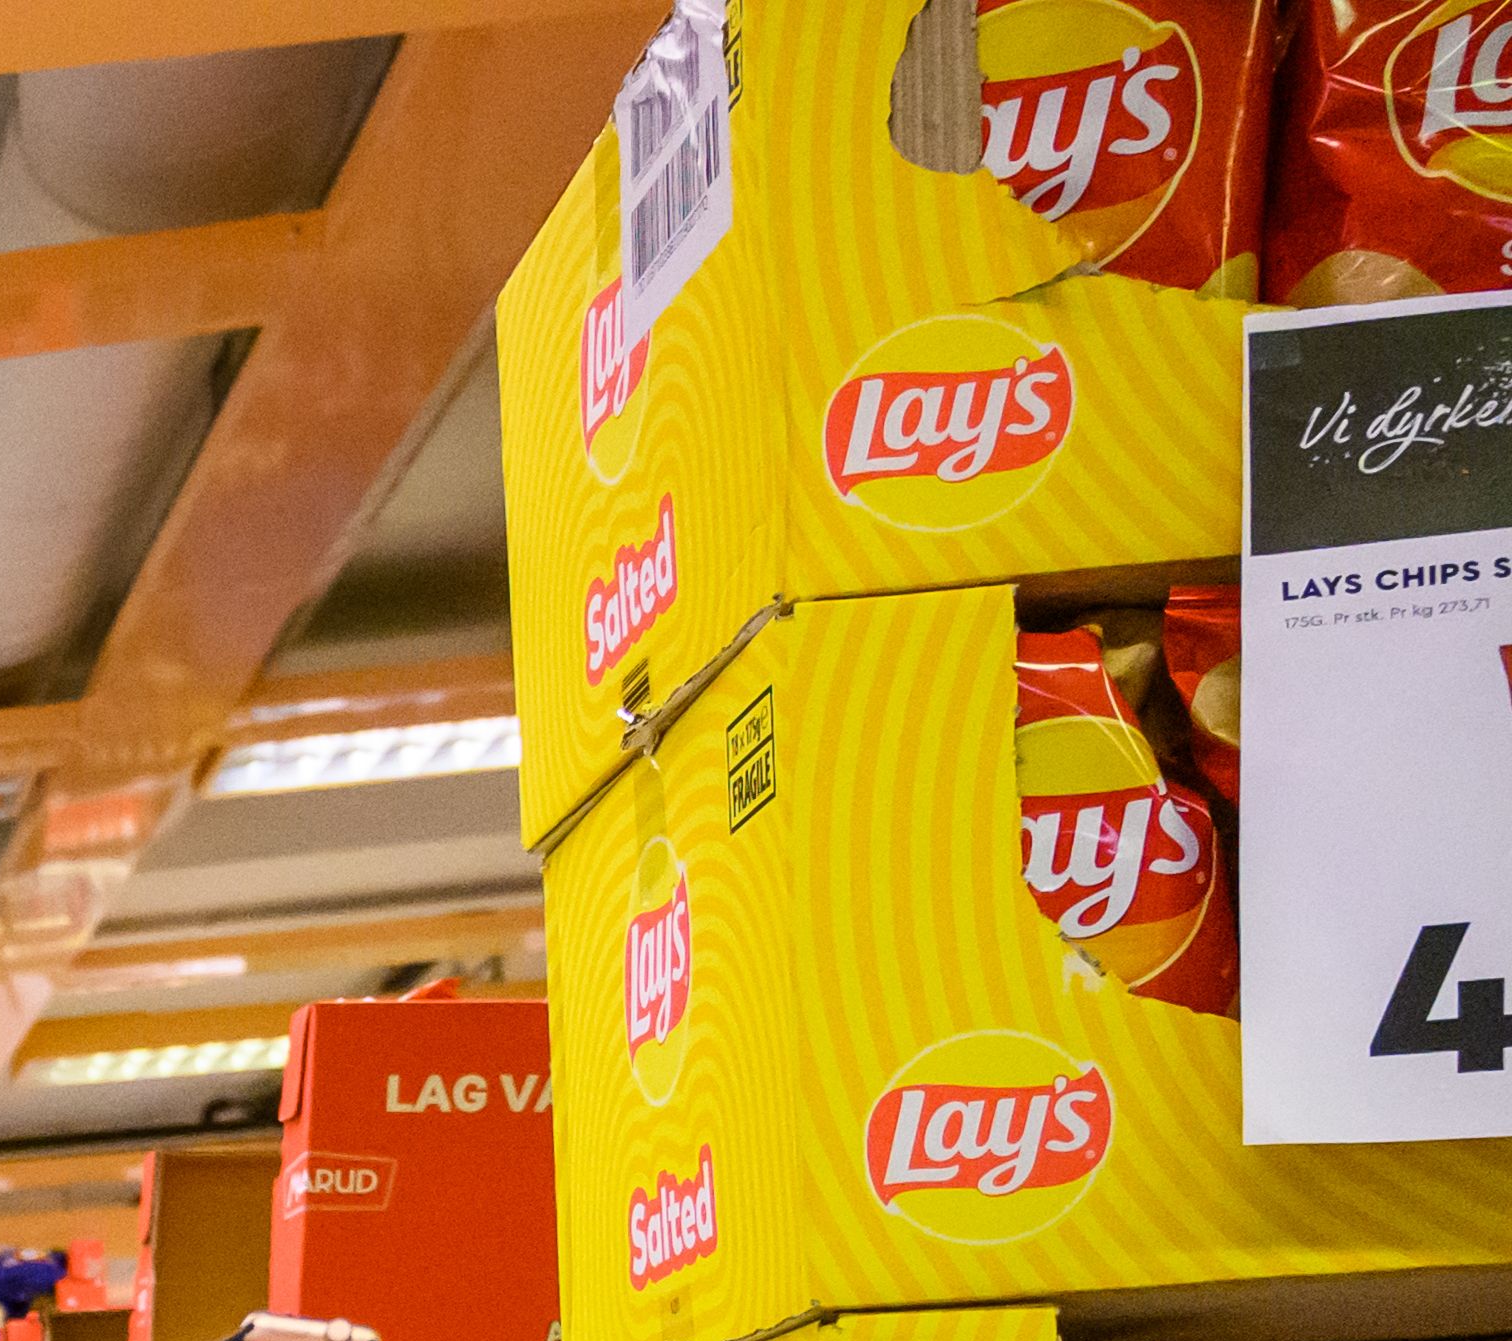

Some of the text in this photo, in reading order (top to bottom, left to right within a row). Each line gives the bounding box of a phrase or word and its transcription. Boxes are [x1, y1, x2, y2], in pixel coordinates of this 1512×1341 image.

[842, 357, 1058, 483] Lay's
[1300, 391, 1356, 449] Vi
[587, 512, 673, 673] Salted
[1281, 573, 1362, 601] LAYS
[1375, 561, 1480, 590] CHIPS
[1390, 605, 1407, 620] Pr
[1411, 603, 1434, 619] kg
[732, 750, 771, 818] FRAGILE
[628, 889, 691, 1043] Lay's
[386, 1074, 488, 1114] LAG
[882, 1075, 1095, 1196] Lay's
[632, 1170, 713, 1280] Salted
